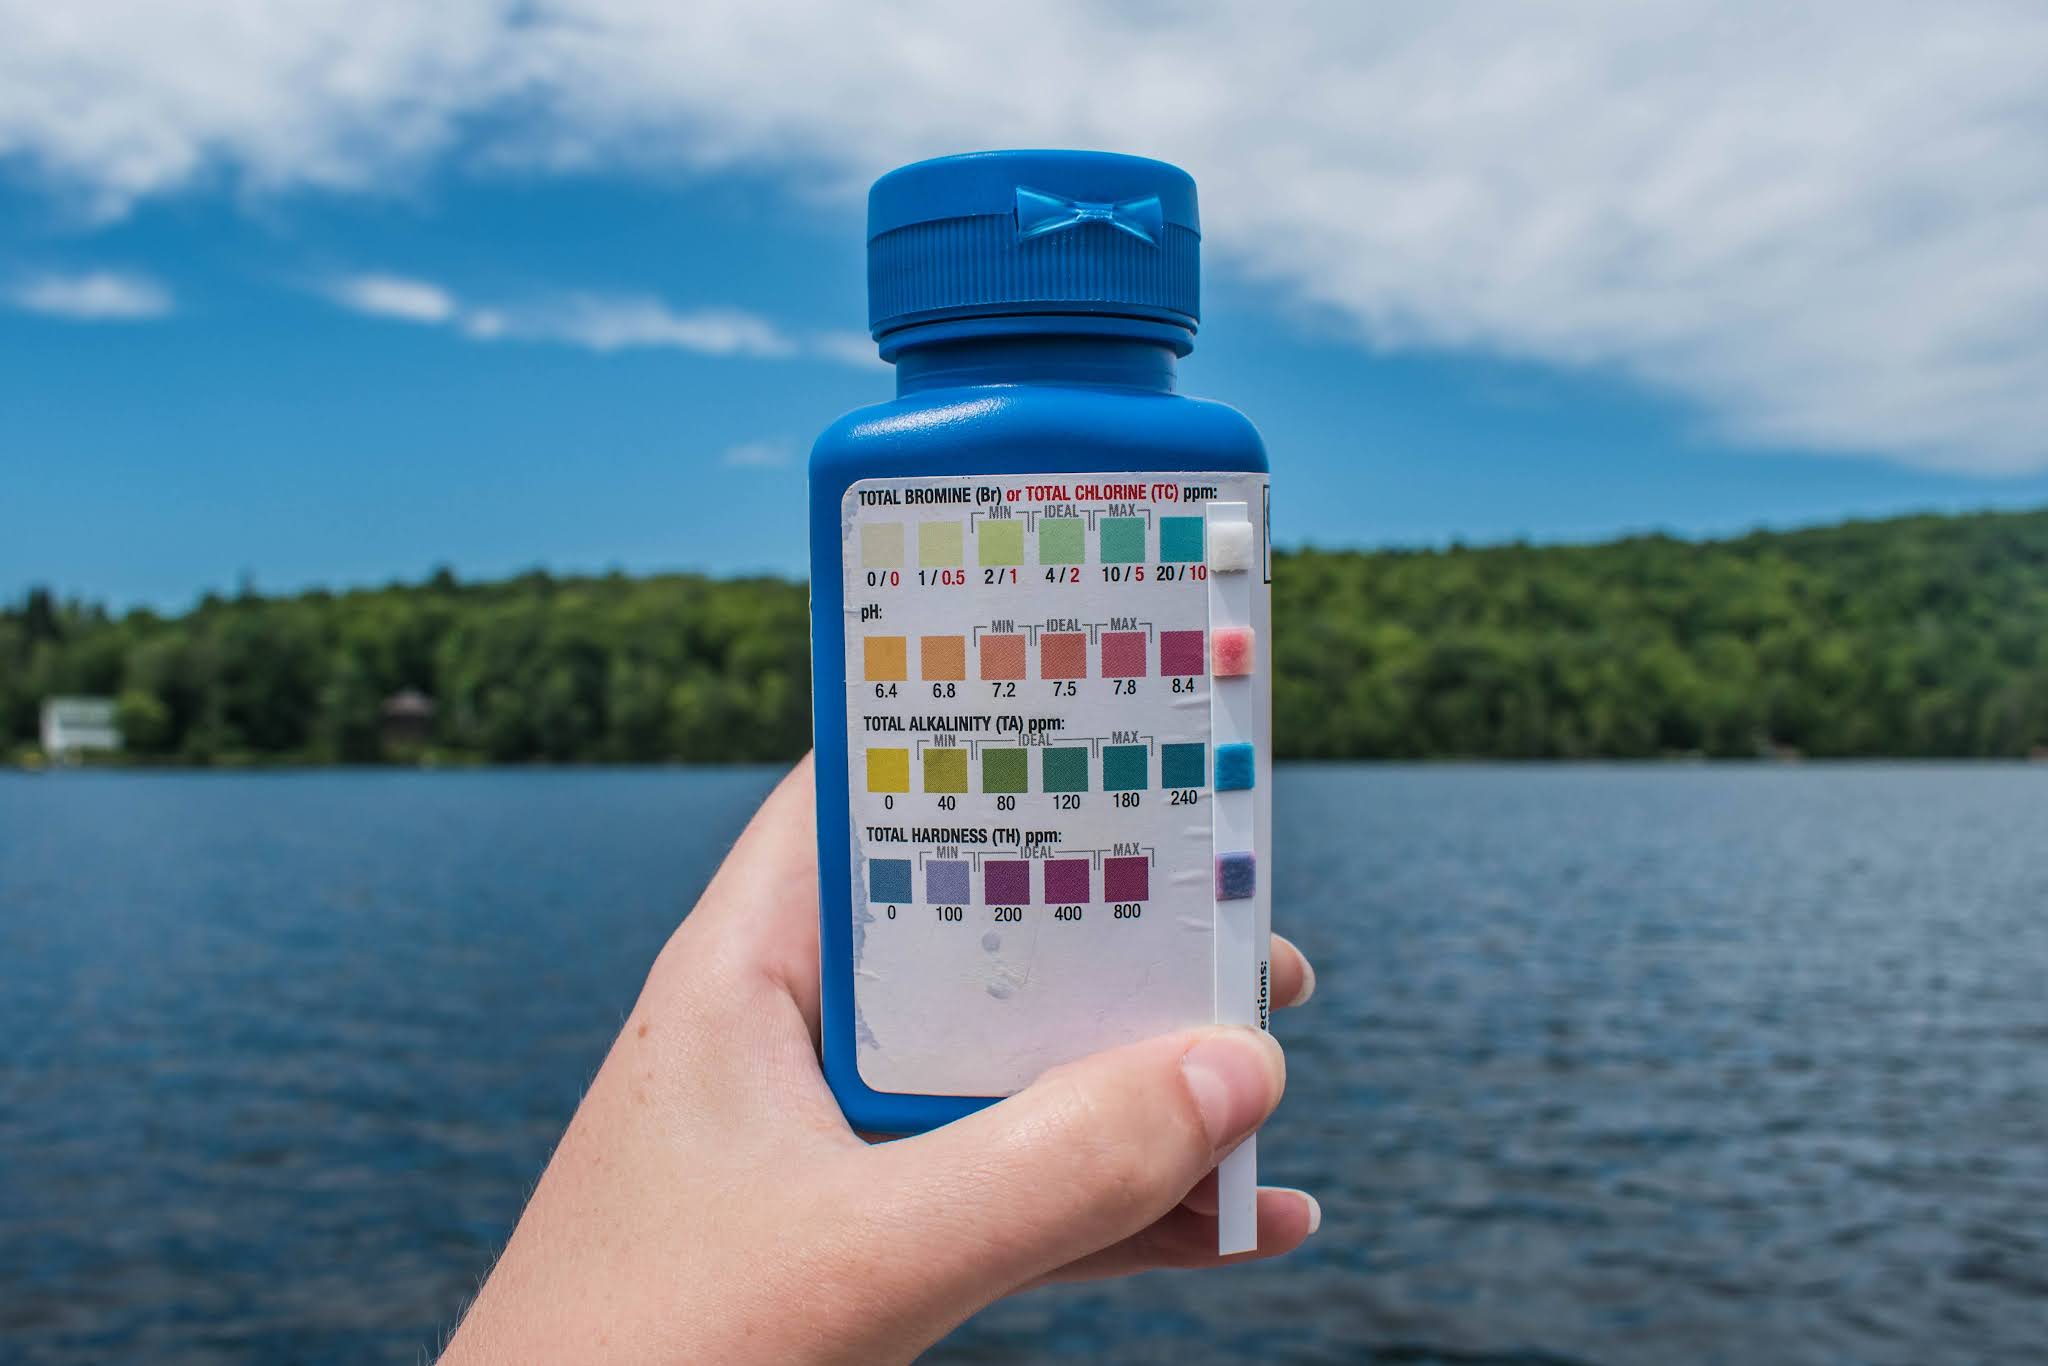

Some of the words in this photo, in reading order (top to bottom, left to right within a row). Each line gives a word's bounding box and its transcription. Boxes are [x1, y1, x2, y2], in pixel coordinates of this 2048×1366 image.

[858, 490, 901, 506] TOTAL
[905, 487, 971, 505] BROMINE
[976, 487, 1002, 506] (Br)
[1006, 488, 1022, 502] or
[1025, 485, 1071, 501] TOTAL
[1075, 484, 1147, 501] CHLORINE
[1151, 484, 1179, 503] (TC)
[1183, 486, 1217, 502] ppm:
[989, 505, 1012, 519] MIN
[1044, 504, 1079, 518] IDEAL
[1109, 504, 1136, 517] MAX
[861, 604, 882, 622] pH:
[991, 620, 1014, 633] MIN
[1046, 619, 1082, 632] IDEAL
[1110, 618, 1137, 631] MAX
[875, 683, 897, 698] 6.4
[933, 683, 955, 698] 6.8
[992, 683, 1016, 697] 7.2
[1053, 682, 1077, 696] 7.5
[1113, 680, 1136, 695] 7.8
[1172, 678, 1194, 693] 8.4
[864, 716, 905, 731] TOTAL
[909, 716, 992, 732] ALKALINITY
[996, 715, 1023, 734] (TA)
[1028, 717, 1065, 734] ppm:
[934, 734, 956, 747] MIN
[1018, 734, 1053, 746] IDEAL
[1112, 731, 1139, 744] MAX
[885, 795, 893, 810] 0
[938, 796, 955, 810] 40
[997, 796, 1015, 810] 80
[1053, 795, 1081, 810] 120
[1113, 793, 1140, 808] 180
[1171, 790, 1197, 805] 240
[867, 827, 908, 842] TOTAL
[912, 828, 988, 843] HARDNESS
[992, 828, 1020, 847] (TH)
[1025, 829, 1062, 846] ppm:
[936, 846, 958, 858] MIN
[1020, 846, 1054, 859] IDEAL
[1113, 842, 1140, 856] MAX
[887, 905, 896, 920] 0
[936, 907, 963, 921] 100
[994, 907, 1022, 922] 200
[1054, 906, 1082, 921] 400
[1114, 904, 1141, 919] 800
[1257, 961, 1267, 1030] ections:
